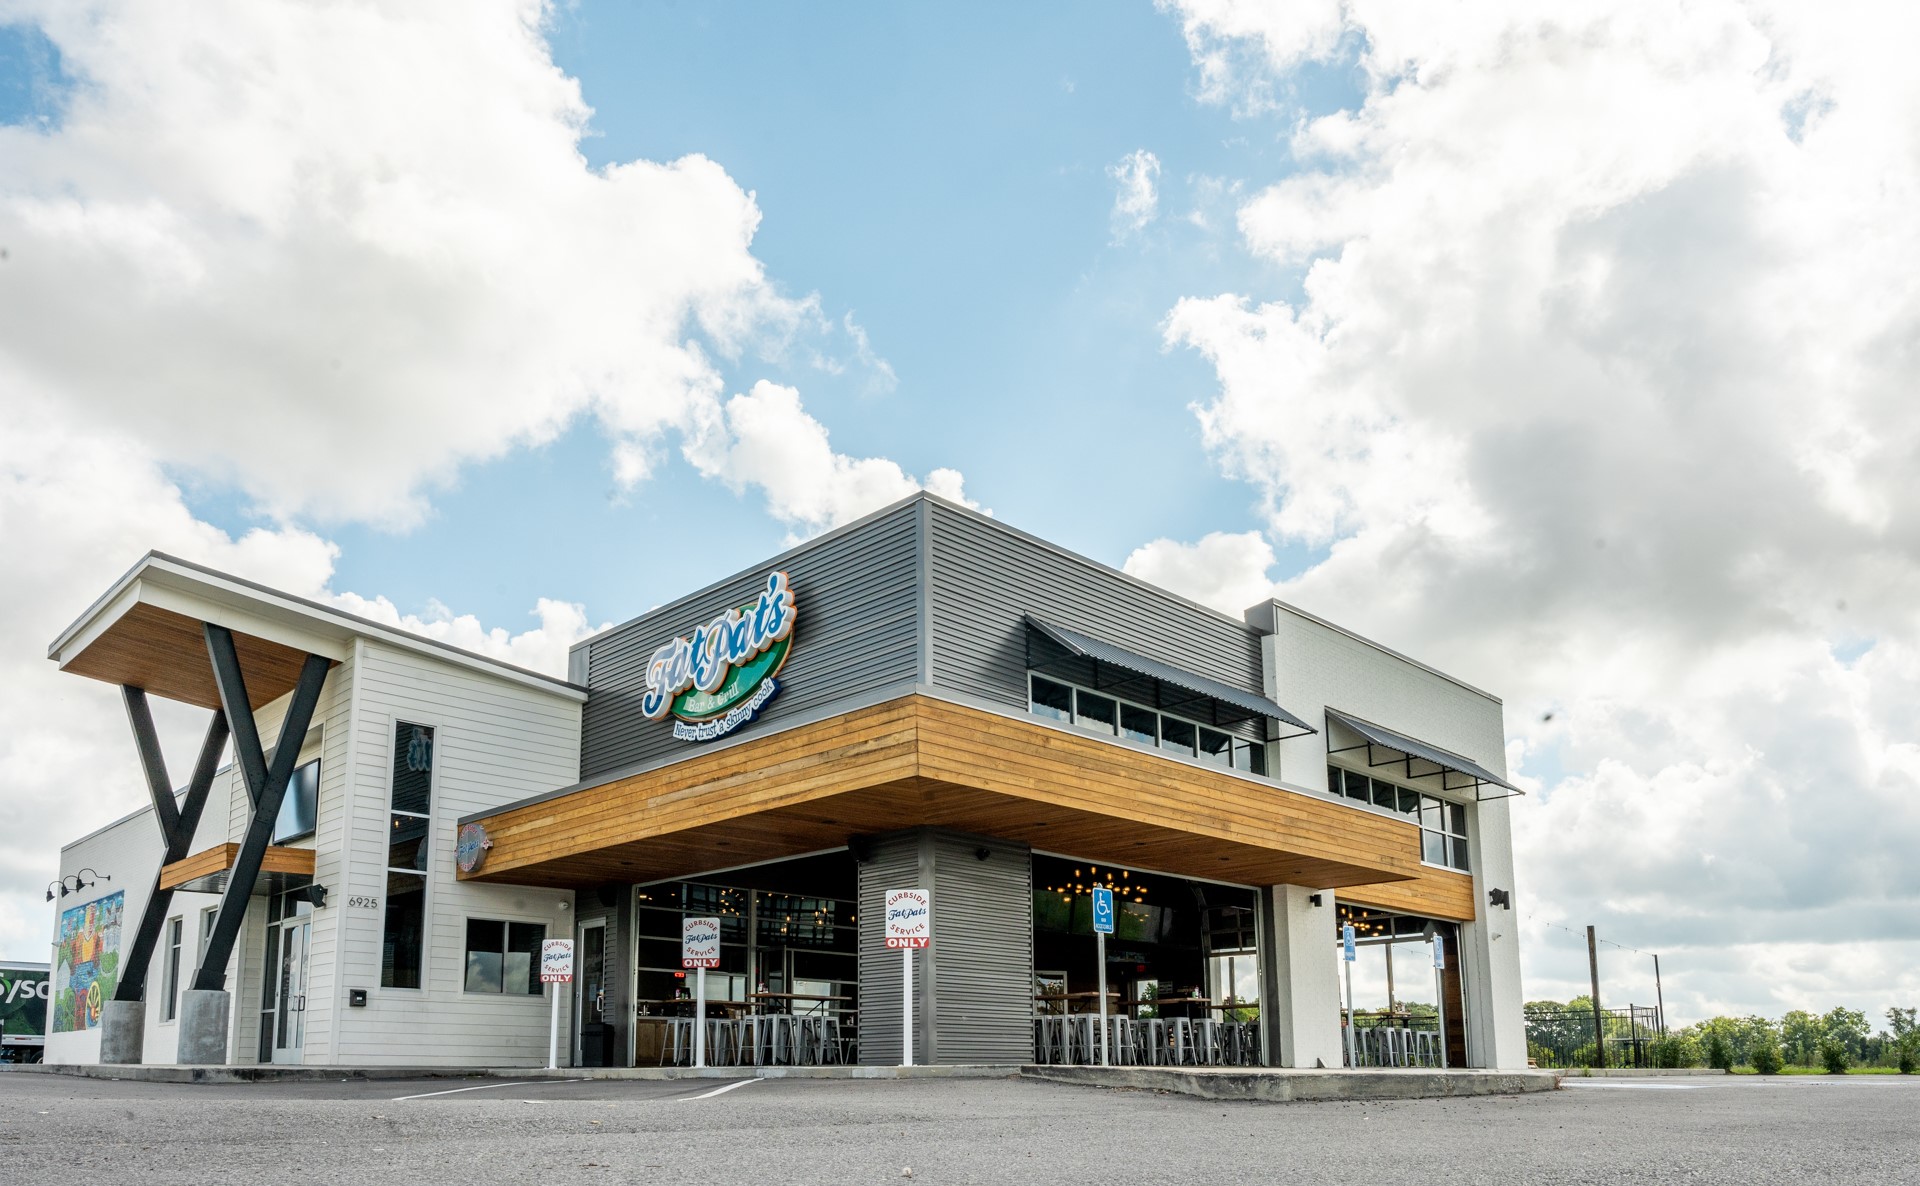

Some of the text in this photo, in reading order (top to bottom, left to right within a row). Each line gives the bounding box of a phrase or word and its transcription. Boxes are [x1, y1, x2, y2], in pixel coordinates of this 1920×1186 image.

[688, 682, 739, 712] Bar & Grill
[674, 680, 773, 738] Never trust a skinny cook
[348, 896, 378, 909] 6925
[888, 891, 927, 906] CURBSIDE
[685, 919, 718, 932] CURBSIDE
[890, 922, 926, 936] SERVICE
[543, 940, 572, 952] CURBSIDE
[887, 938, 928, 948] ONLY
[686, 946, 716, 957] SERVICE
[544, 963, 570, 973] SERVICE
[684, 959, 718, 967] ONLY
[541, 974, 571, 982] ONLY
